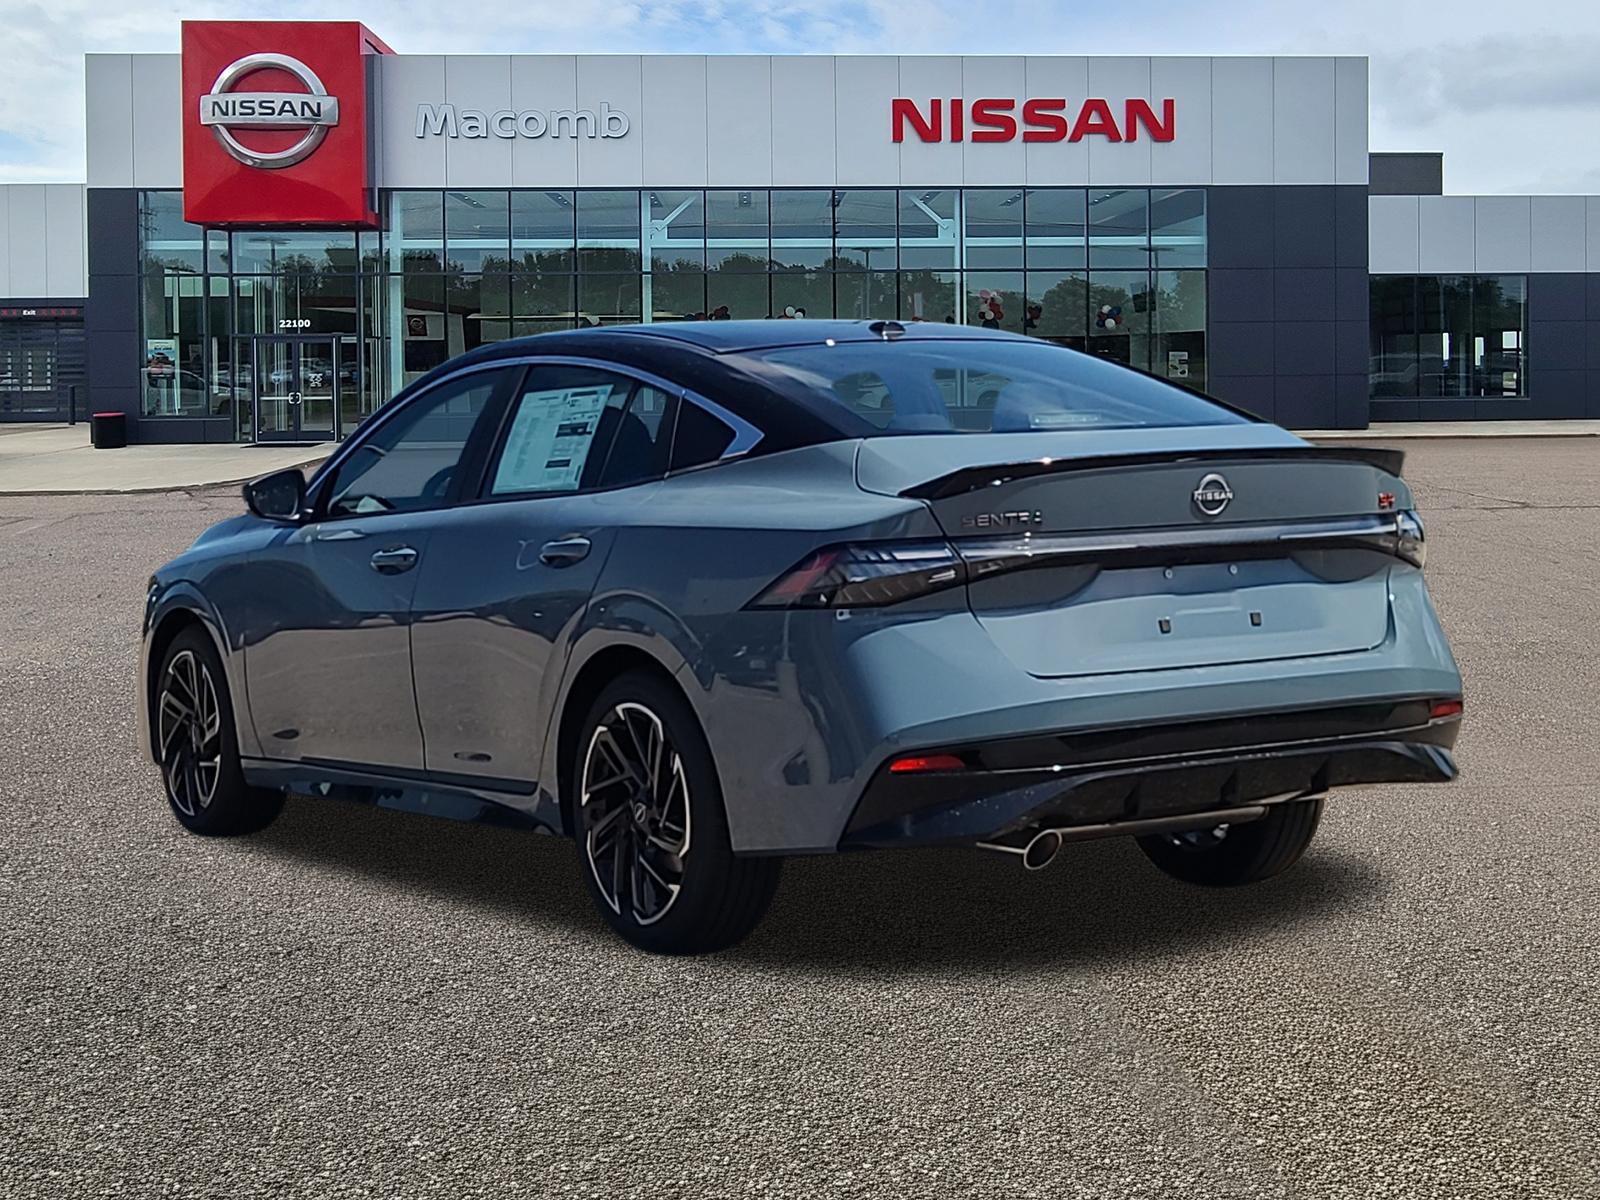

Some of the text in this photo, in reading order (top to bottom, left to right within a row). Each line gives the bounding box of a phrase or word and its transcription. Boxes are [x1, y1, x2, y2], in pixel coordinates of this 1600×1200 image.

[212, 100, 321, 118] NISSAN
[415, 102, 630, 139] Macomb
[891, 98, 1176, 143] NISSAN
[279, 319, 311, 328] 22100
[1193, 490, 1233, 501] NISSAN
